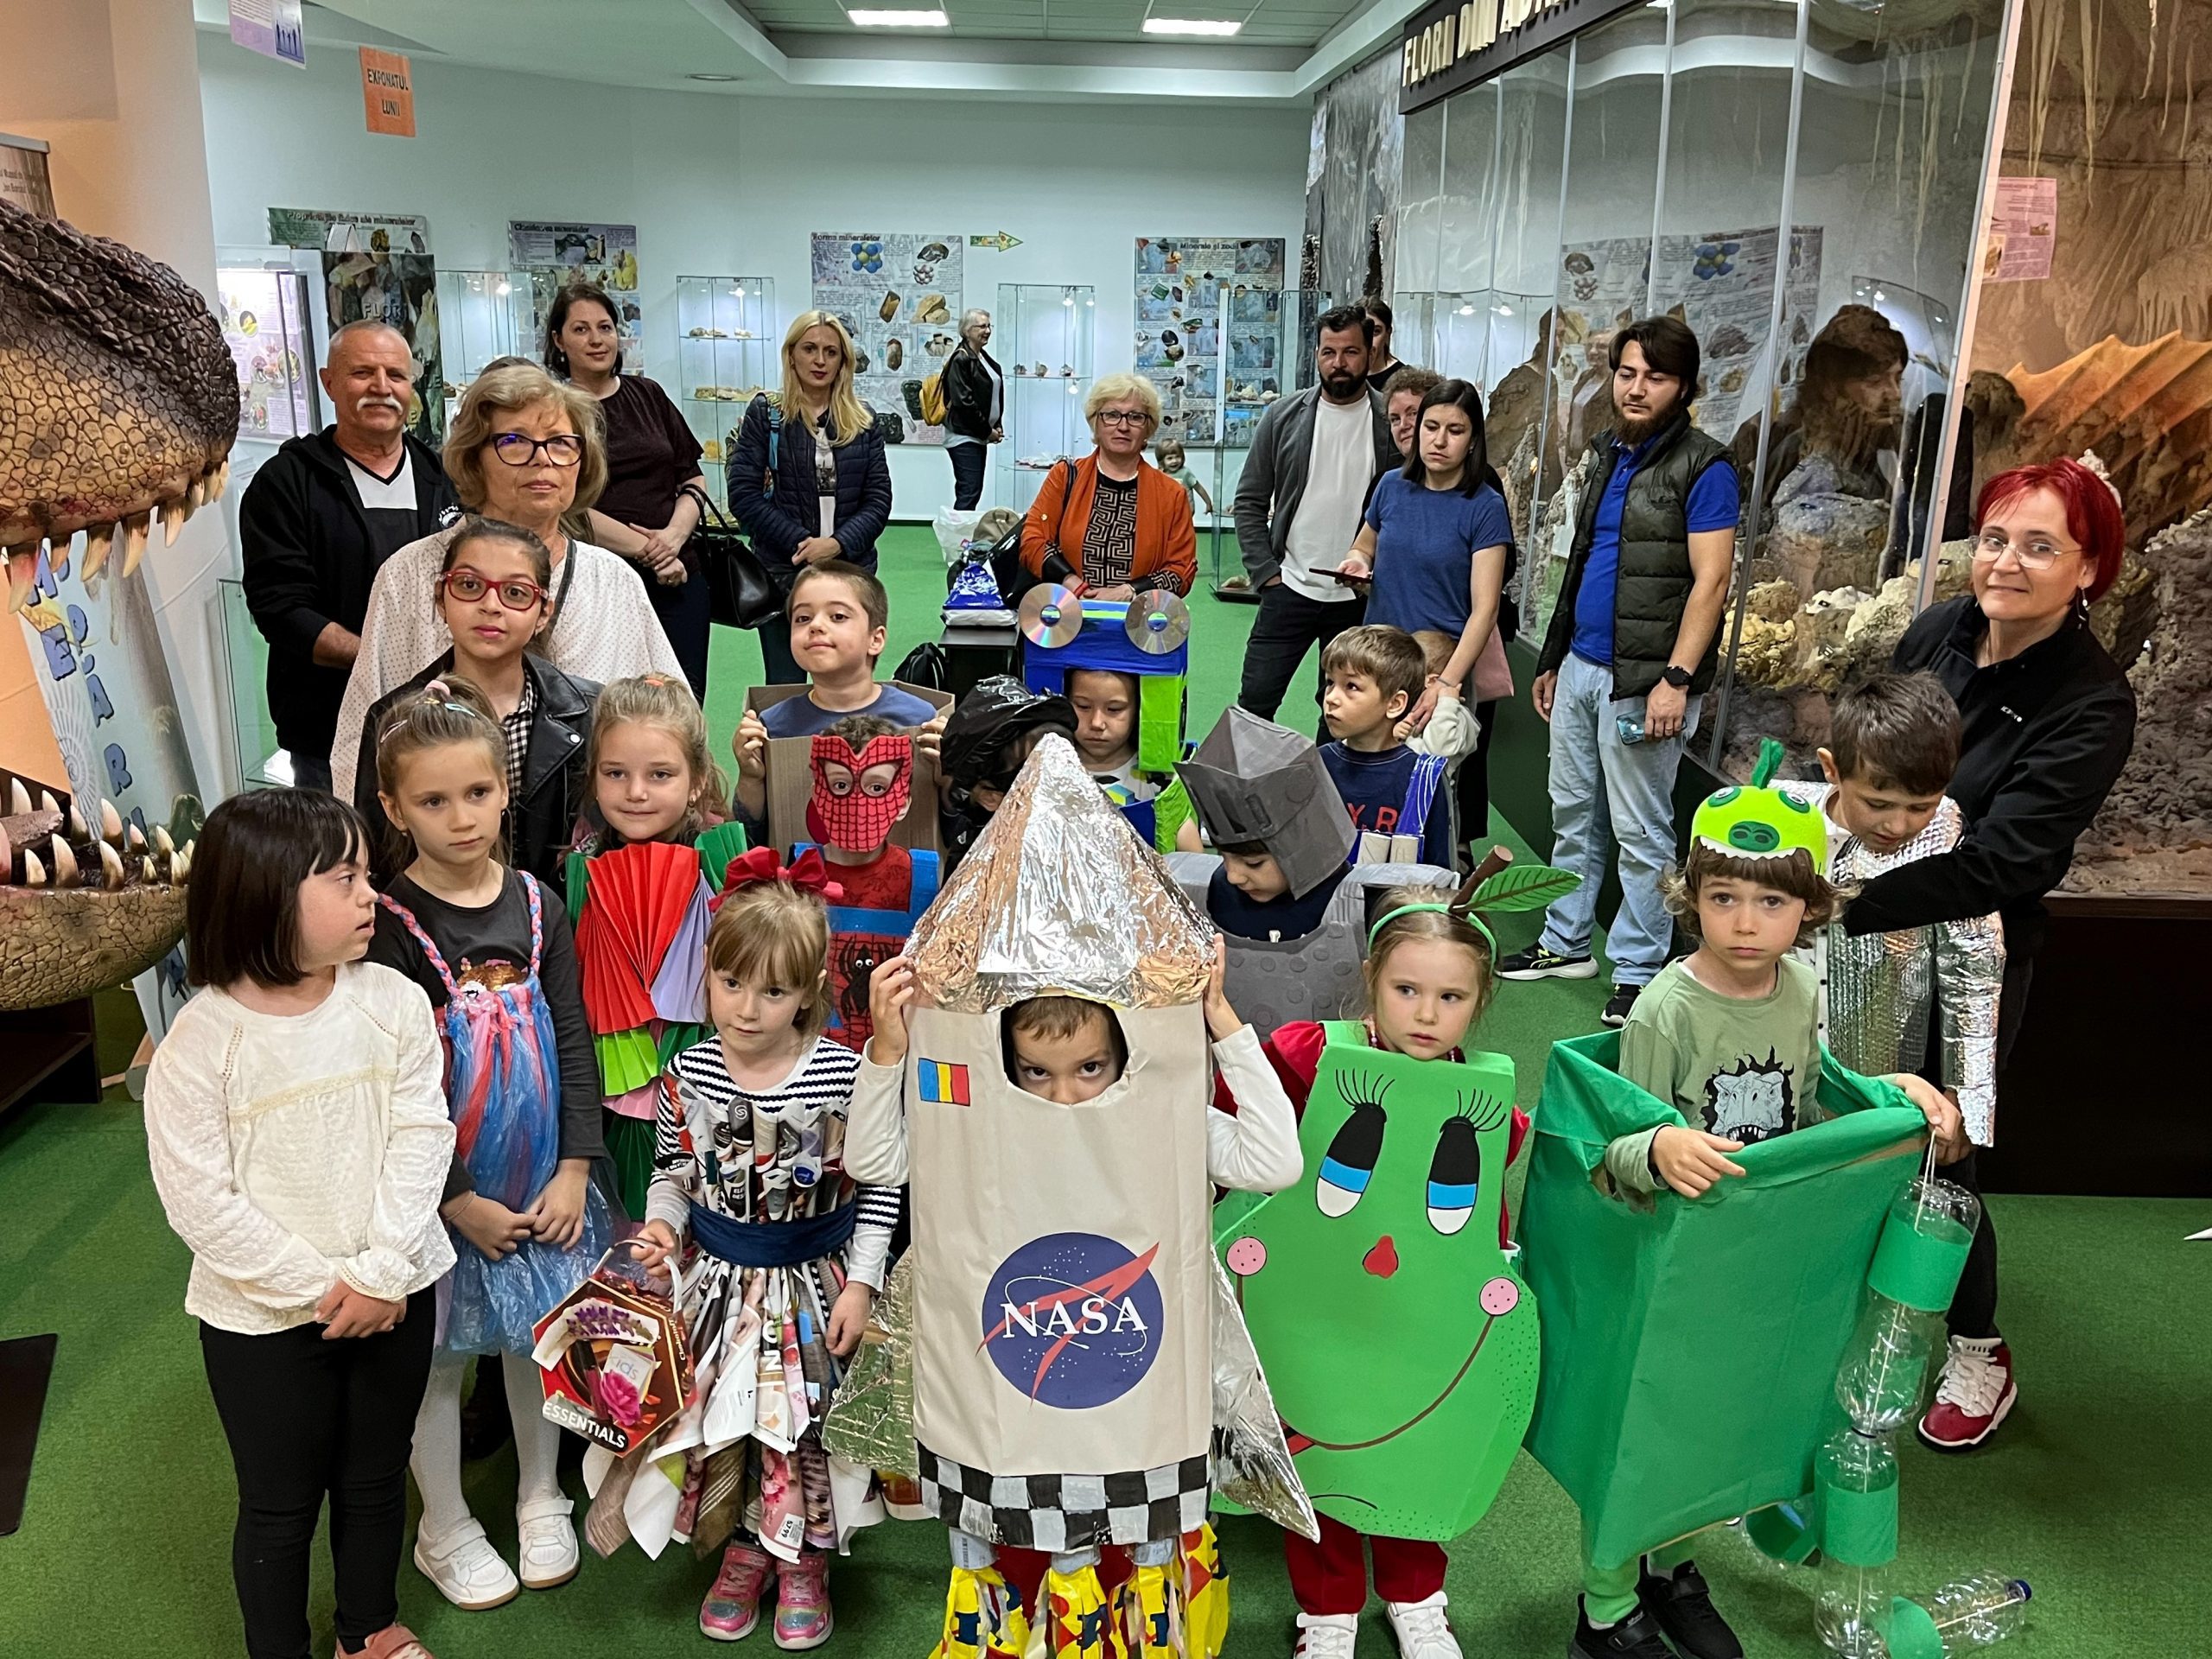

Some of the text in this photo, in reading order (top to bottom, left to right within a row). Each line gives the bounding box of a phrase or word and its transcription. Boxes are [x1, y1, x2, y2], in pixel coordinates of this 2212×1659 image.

[1402, 15, 1456, 87] FLORI
[1458, 0, 1498, 59] DIN
[366, 68, 409, 91] EXPONATUL
[381, 99, 400, 117] LUNII
[1001, 1296, 1148, 1338] NASA
[542, 1400, 626, 1449] ESSENTIALS
